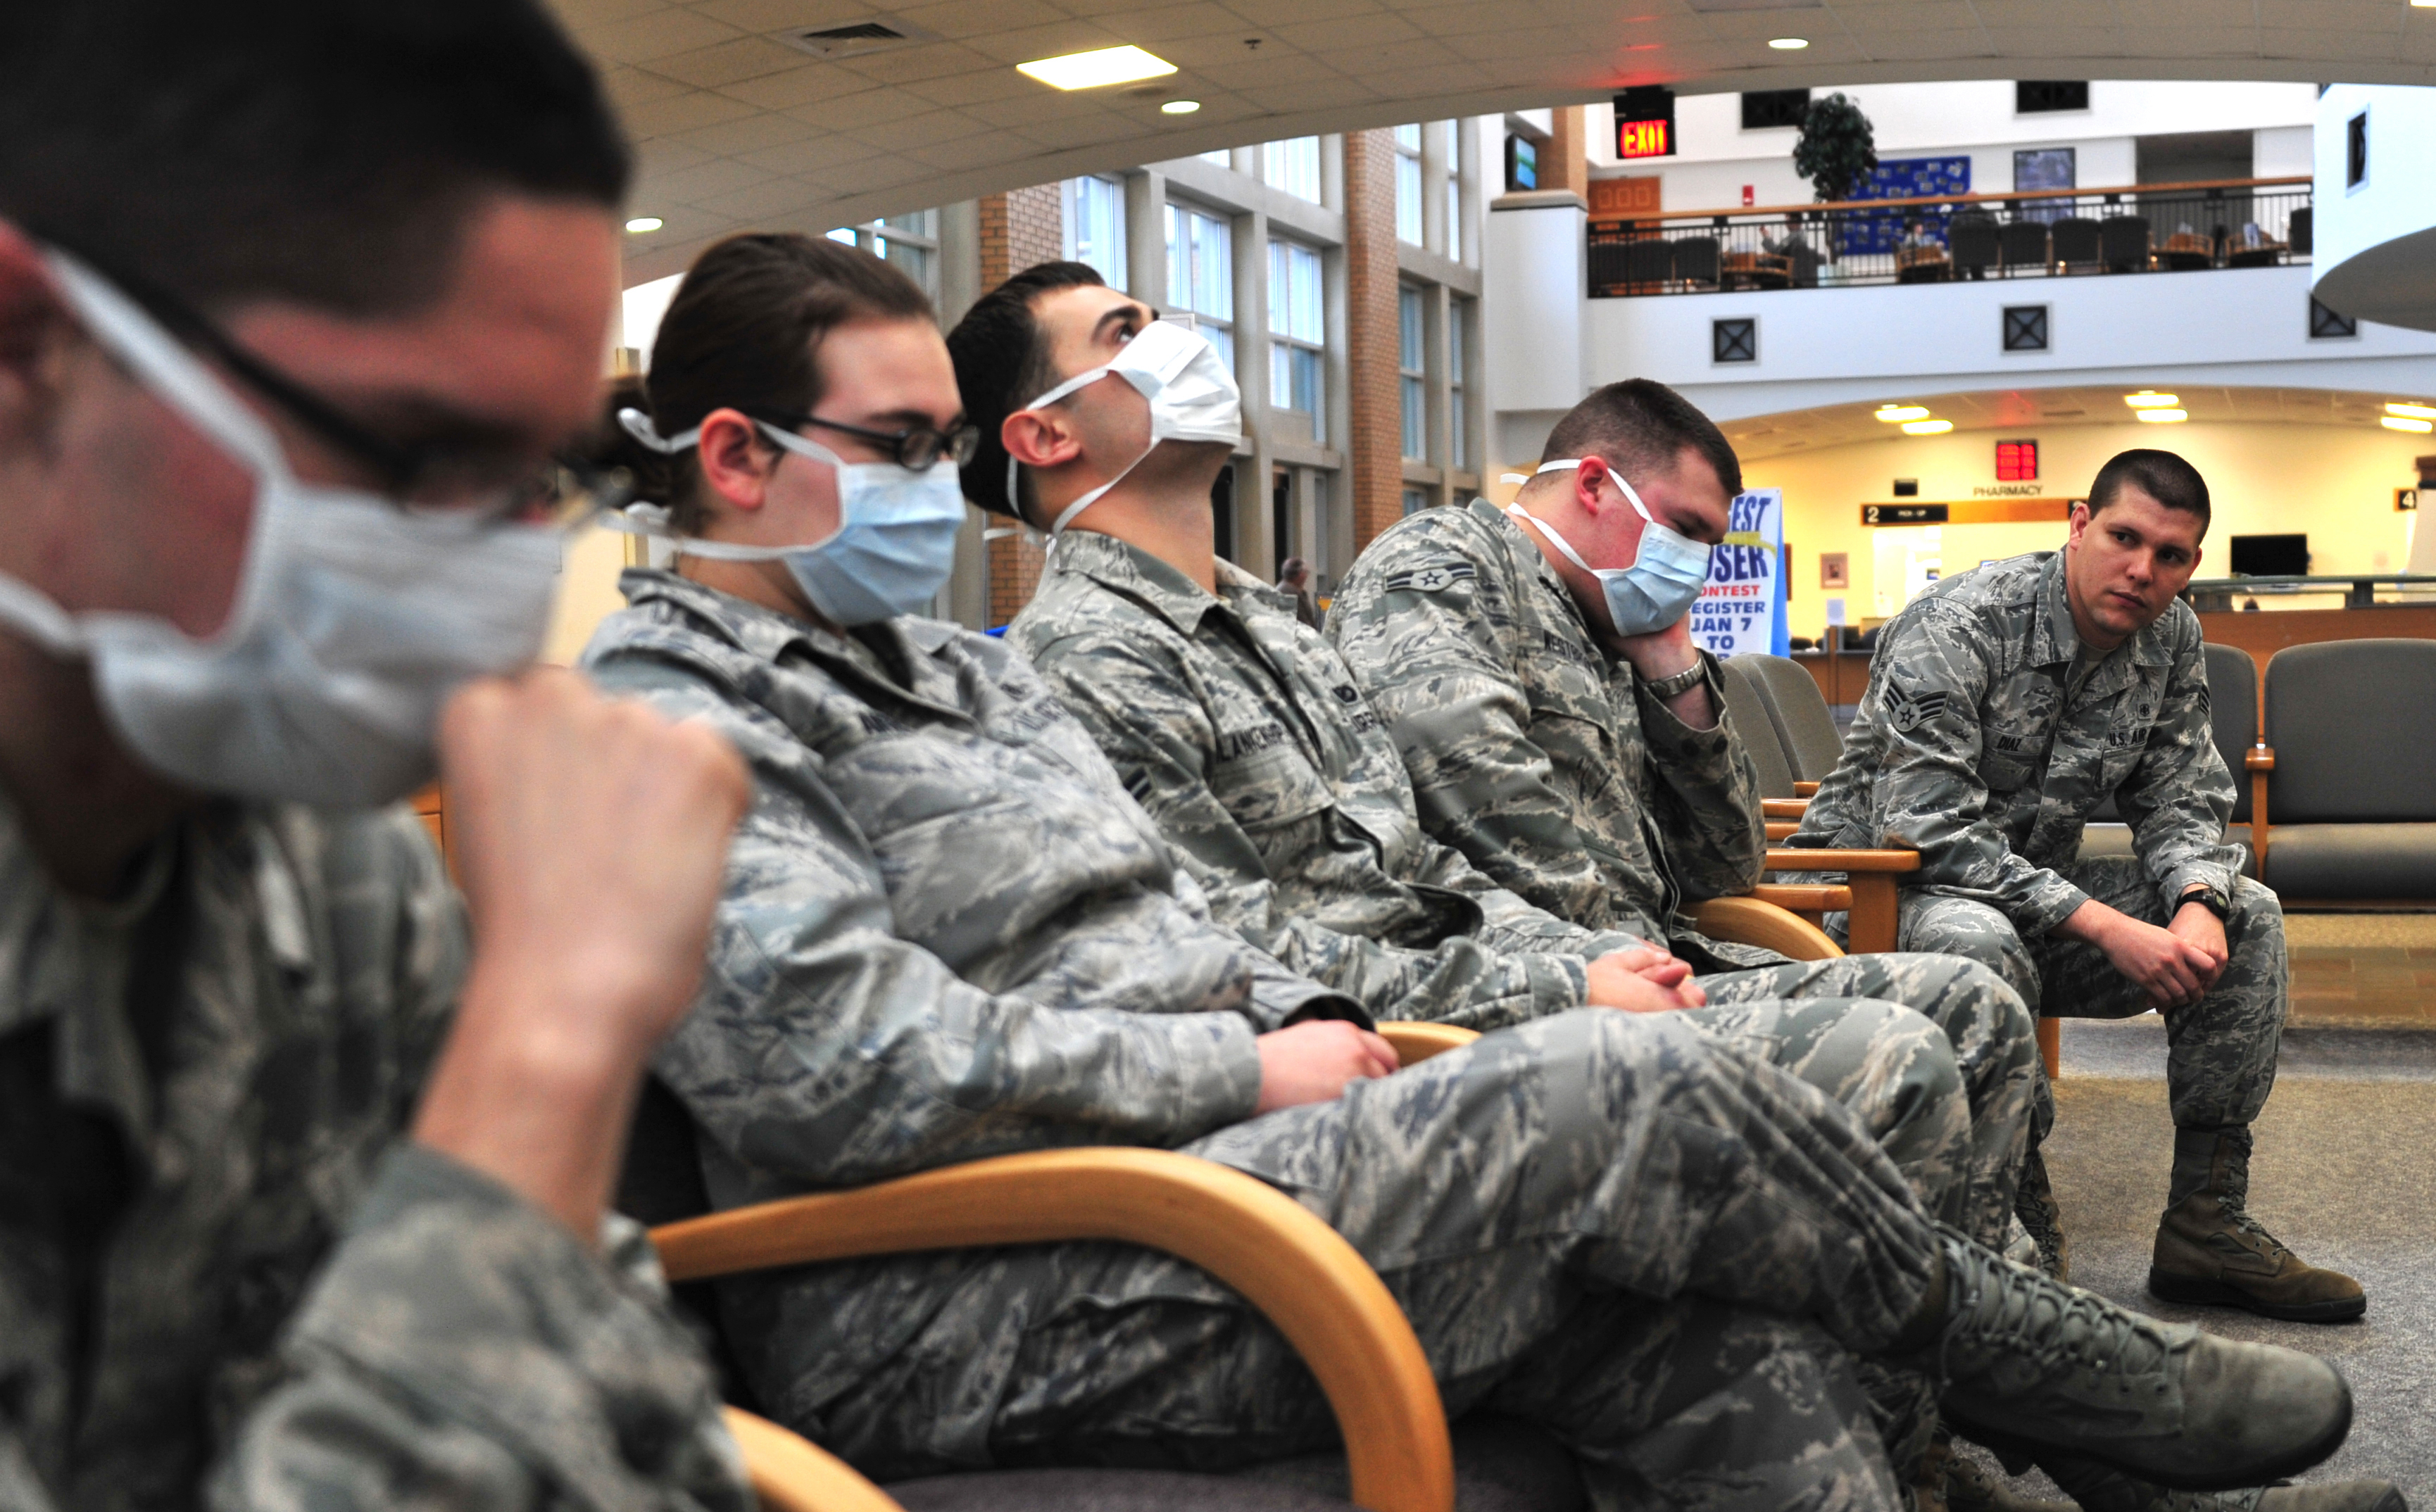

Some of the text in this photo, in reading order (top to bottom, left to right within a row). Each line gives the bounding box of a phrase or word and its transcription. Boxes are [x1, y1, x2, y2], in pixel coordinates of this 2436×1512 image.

[1621, 120, 1667, 158] EXIT
[1973, 485, 2043, 496] PHARMACY
[2402, 491, 2414, 508] 4
[1728, 496, 1772, 531] EST
[1868, 506, 1880, 523] 2
[1691, 601, 1766, 614] EGISTER
[1690, 617, 1752, 632] JAN 7
[1707, 635, 1735, 650] TO
[1997, 736, 2022, 752] DIAZ
[2109, 728, 2147, 747] U.S. AIR
